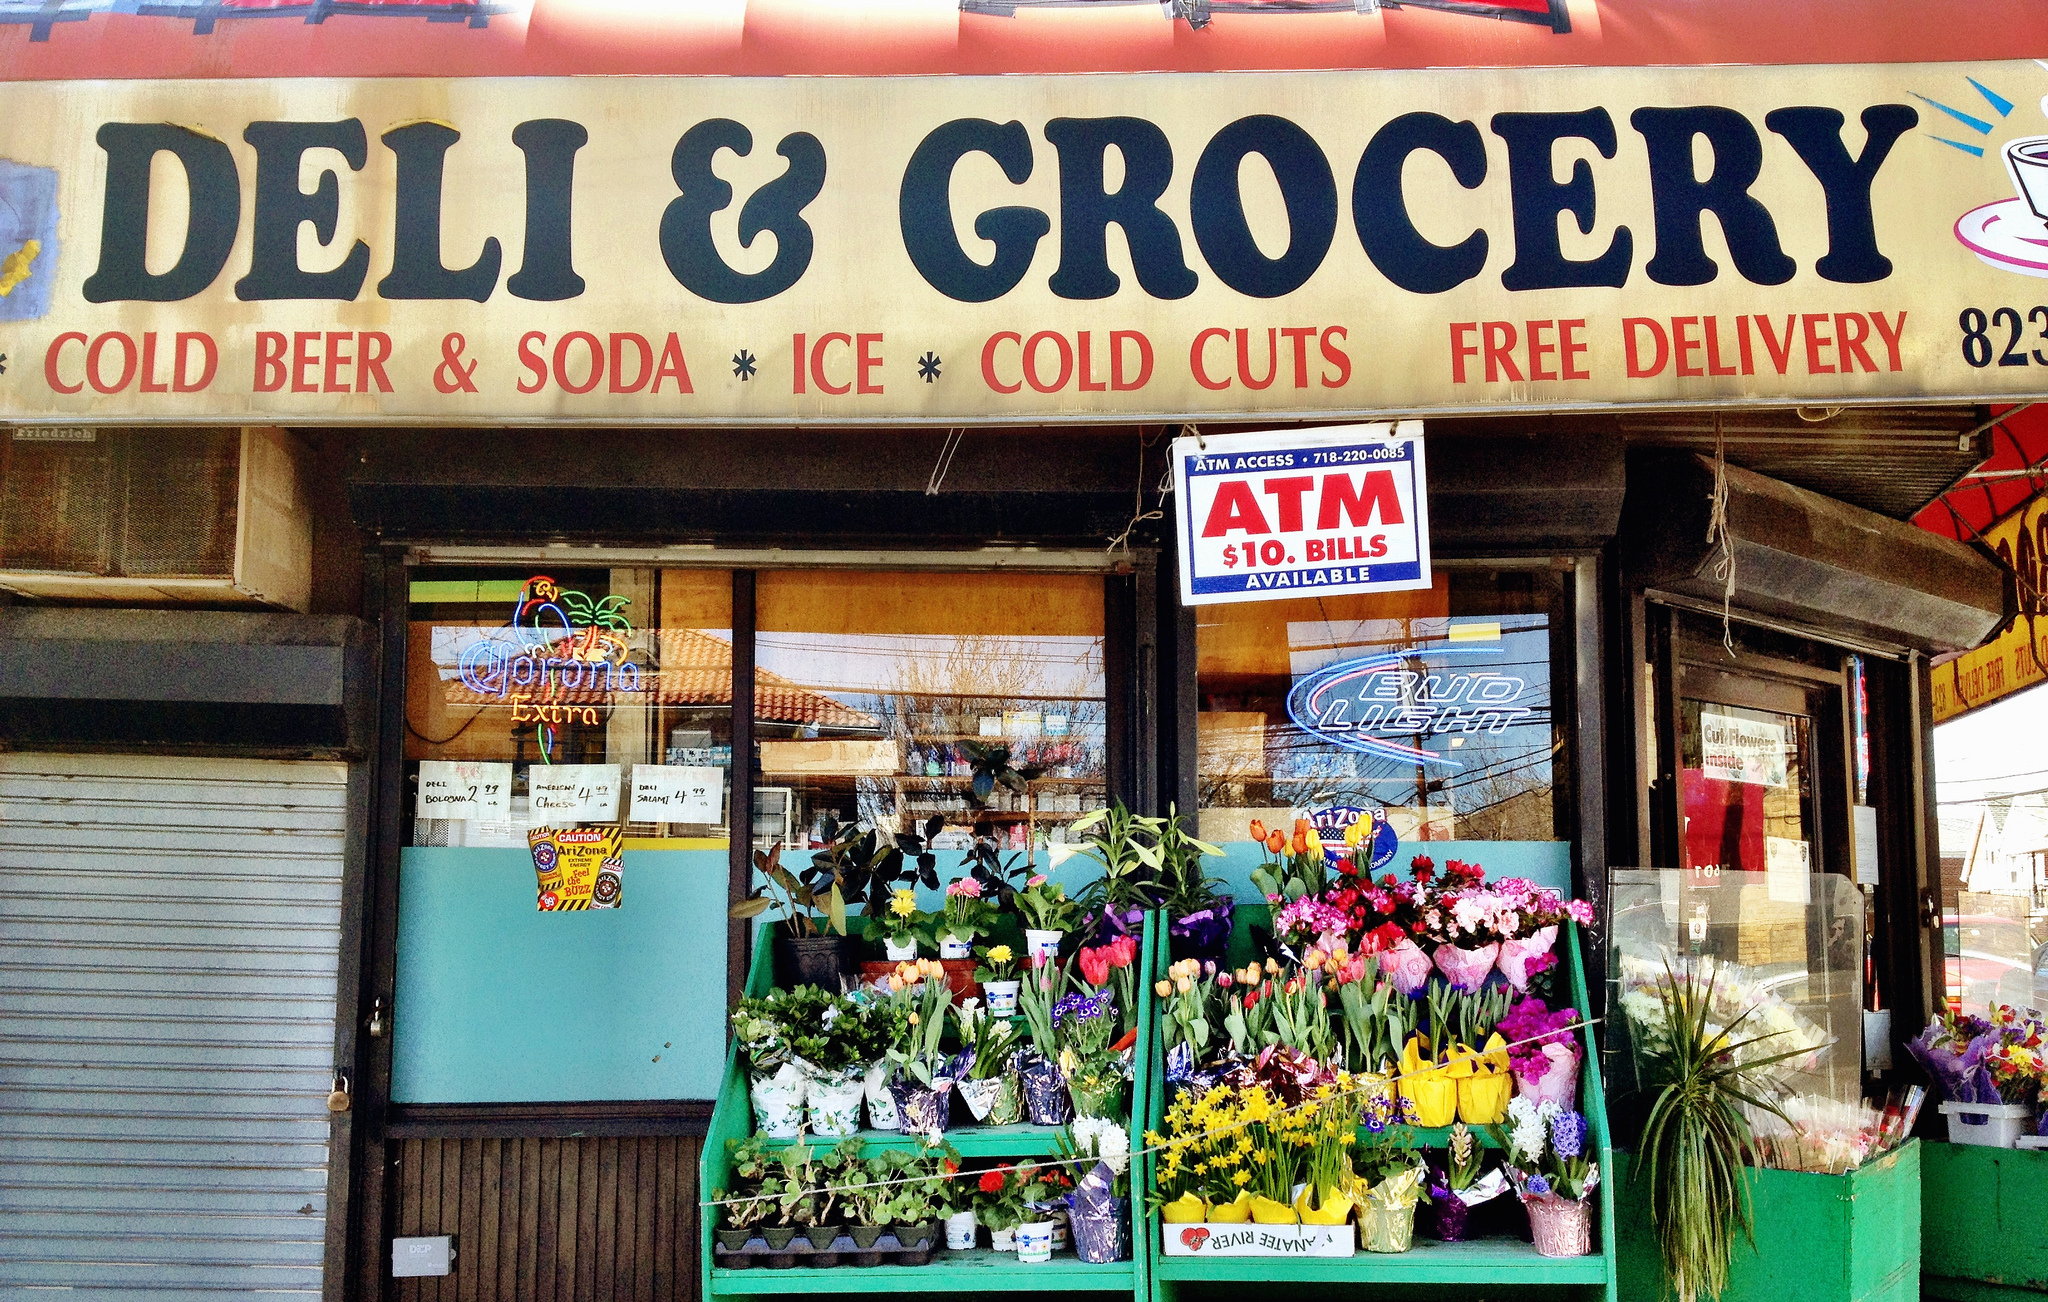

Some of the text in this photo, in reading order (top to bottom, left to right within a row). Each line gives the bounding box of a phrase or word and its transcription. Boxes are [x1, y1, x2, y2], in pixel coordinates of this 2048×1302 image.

[82, 103, 1920, 304] DELI & GROCERY
[1958, 305, 2048, 369] 823
[44, 310, 1908, 395] COLD BEER & SODA ICE COLD CUTS FREE DELIVERY
[1195, 447, 1406, 472] ATM ACCESS 718-220-0085
[1201, 469, 1405, 538] ATM
[1222, 534, 1388, 569] $10. BILLS
[1245, 566, 1371, 589] AVAILABLE
[459, 639, 641, 698] Corona
[1358, 671, 1526, 703] BUD
[510, 693, 600, 726] Extra
[1317, 699, 1532, 734] LIGHT
[1704, 723, 1777, 753] Cut Flowers
[468, 785, 478, 803] 2
[578, 786, 594, 806] 4
[674, 790, 688, 804] 4
[558, 833, 602, 842] CAUTION
[556, 845, 608, 857] AriZona
[567, 876, 581, 886] the
[573, 868, 590, 880] Feel
[564, 884, 591, 897] BUZZ
[1211, 1231, 1334, 1252] ANATEE RIVER
